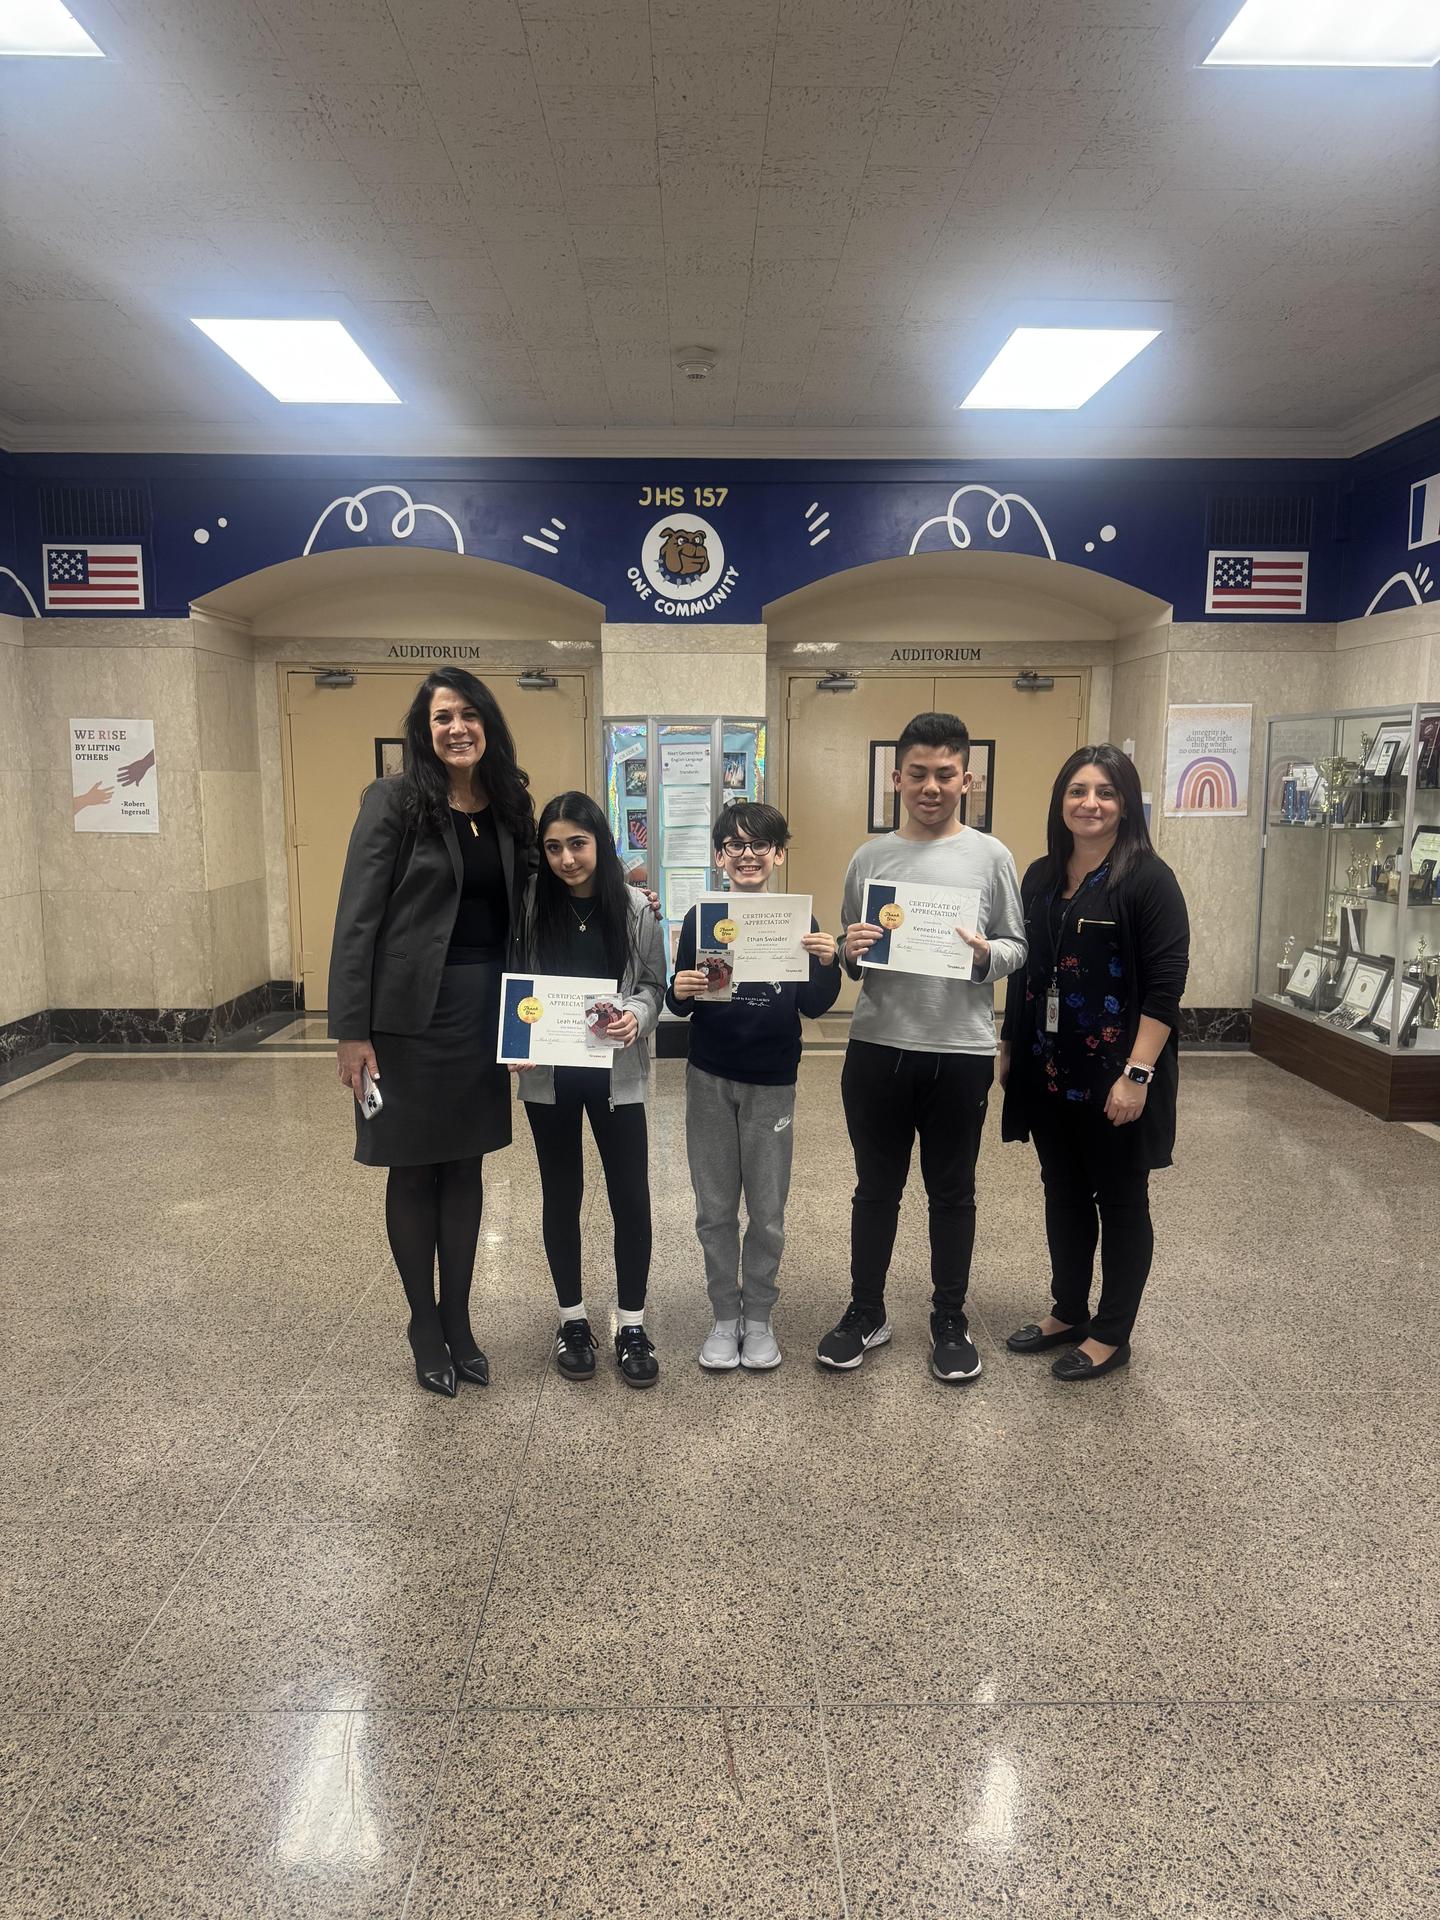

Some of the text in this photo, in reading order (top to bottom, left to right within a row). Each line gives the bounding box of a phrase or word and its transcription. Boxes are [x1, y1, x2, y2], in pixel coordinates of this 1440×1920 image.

[638, 487, 729, 507] JHS 157
[627, 565, 740, 617] ONE COMMUNITY
[387, 645, 480, 658] AUDITORIUM
[890, 648, 982, 661] AUDITORIUM
[74, 729, 127, 740] WE RISE
[87, 744, 121, 752] LIFTING
[75, 753, 109, 761] OTHERS
[908, 900, 950, 910] CERTIFICATE
[910, 908, 958, 918] APPRECIATION
